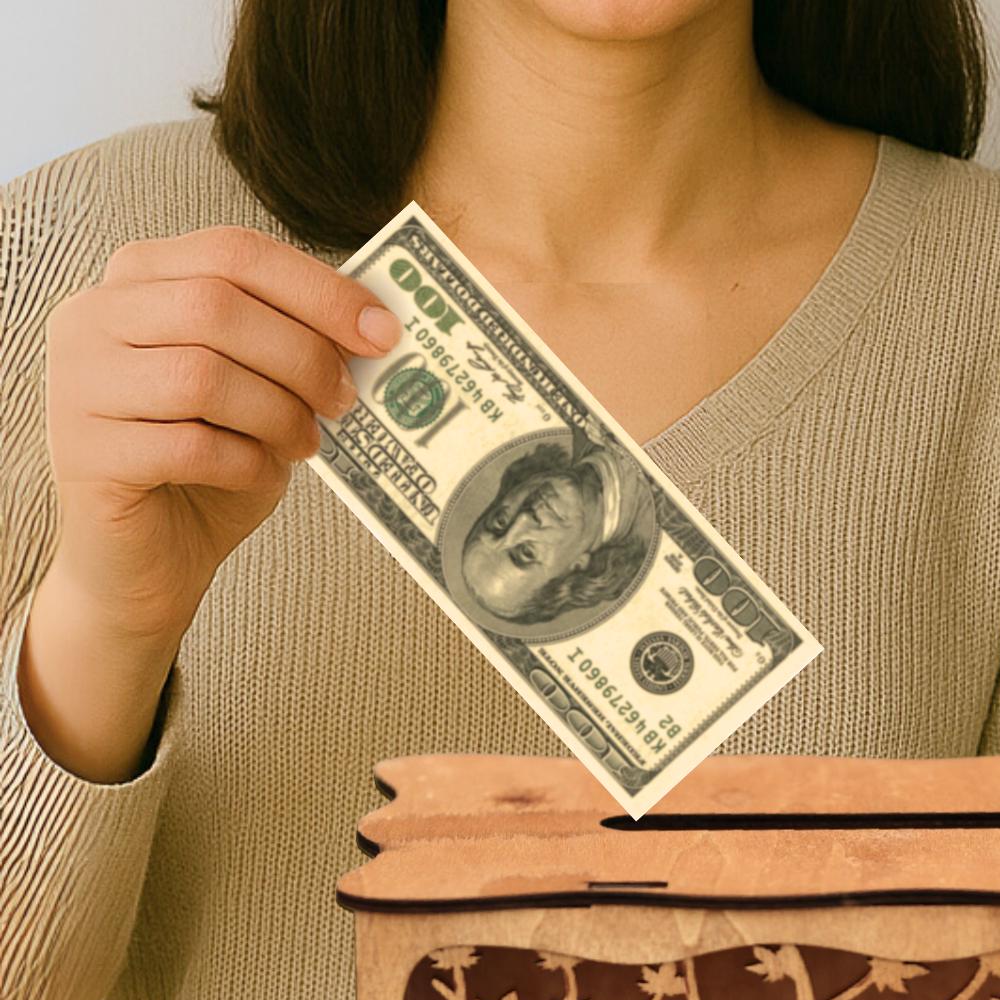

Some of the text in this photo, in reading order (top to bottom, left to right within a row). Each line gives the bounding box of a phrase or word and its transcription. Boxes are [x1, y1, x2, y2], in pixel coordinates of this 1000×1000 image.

[388, 257, 466, 340] 100
[407, 231, 481, 313] DOLLARS
[413, 325, 485, 403] 46279860
[477, 307, 555, 393] HUNDRED
[346, 396, 415, 470] AMER
[478, 397, 503, 423] KB
[551, 389, 587, 428] ONE
[365, 440, 443, 525] UNITED
[404, 459, 439, 496] OF
[691, 554, 778, 648] 100
[537, 646, 564, 675] NOTE
[576, 656, 648, 734] 46279860
[642, 728, 667, 754] KB
[657, 713, 682, 739] B2
